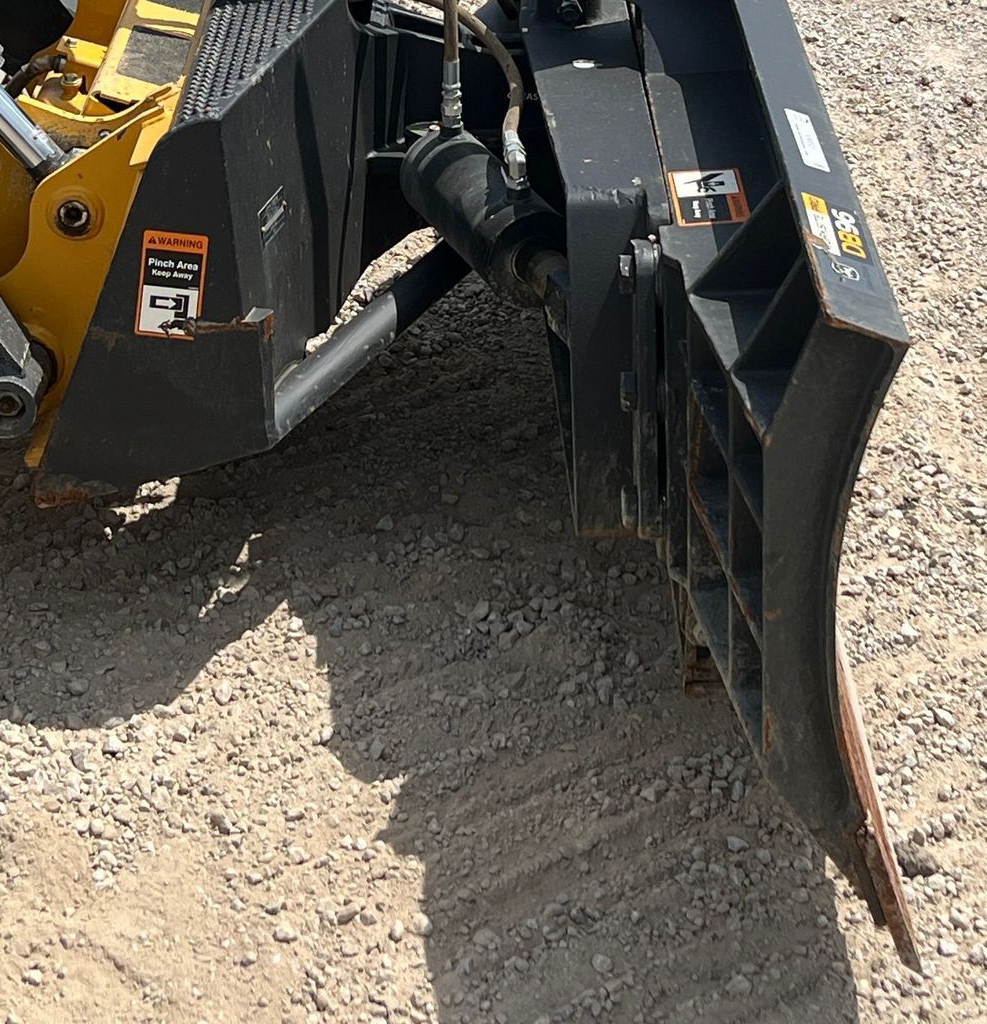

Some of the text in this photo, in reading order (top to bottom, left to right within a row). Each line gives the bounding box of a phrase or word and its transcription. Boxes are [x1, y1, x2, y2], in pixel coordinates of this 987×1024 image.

[830, 208, 867, 259] DB96
[157, 237, 203, 249] WARNING
[148, 257, 199, 271] Pinch Area
[151, 269, 194, 281] Keep Away
